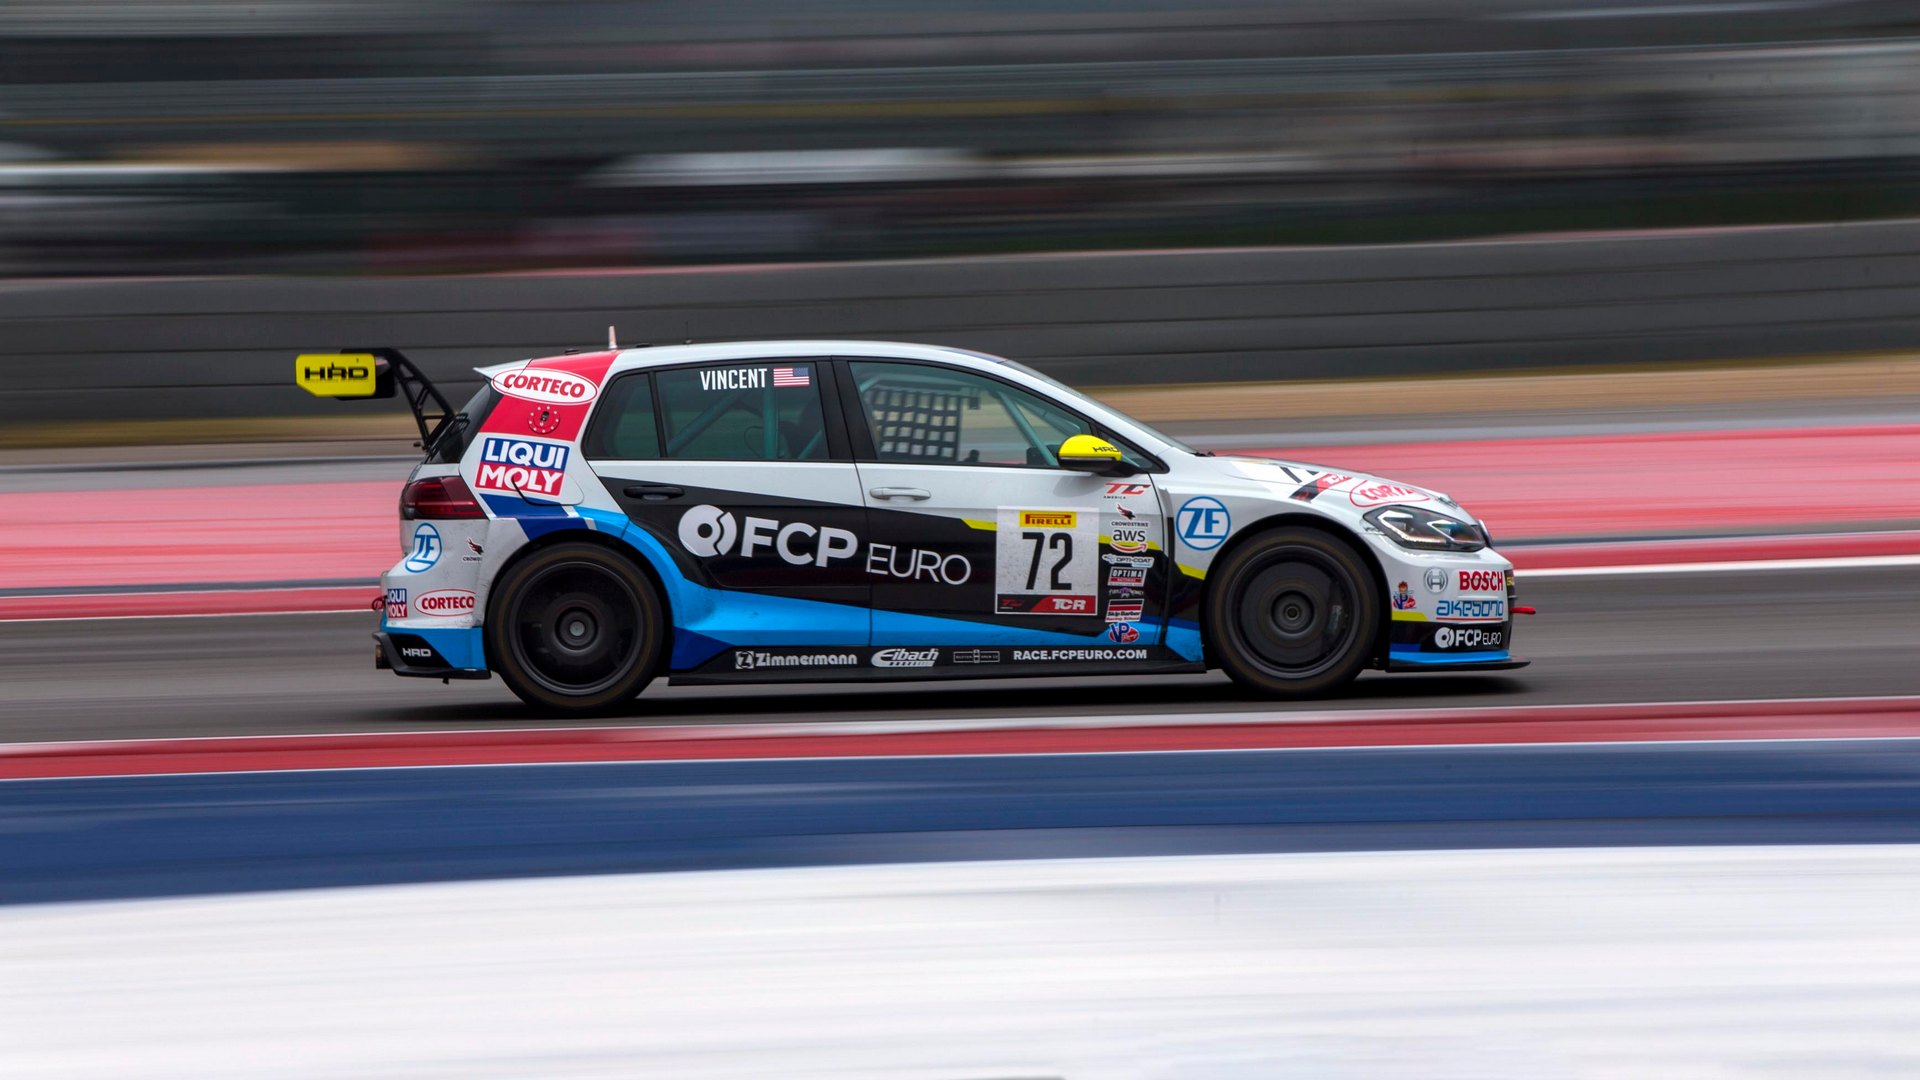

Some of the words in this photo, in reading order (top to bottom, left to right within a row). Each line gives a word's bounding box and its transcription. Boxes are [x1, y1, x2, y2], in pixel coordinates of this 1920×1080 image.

[304, 367, 369, 380] HRD
[700, 368, 767, 391] VINCENT
[503, 373, 586, 399] CORTECO
[485, 439, 566, 470] LIQUI
[479, 464, 563, 493] MOLY
[1105, 482, 1151, 495] TC
[1025, 514, 1072, 525] PIRELLI
[1112, 529, 1146, 542] aws
[740, 516, 858, 568] FCP
[866, 543, 971, 585] EURO
[1022, 532, 1073, 590] 72
[1112, 570, 1142, 578] OPTIMA
[1459, 571, 1503, 591] BOSCH
[421, 596, 474, 610] CORTECO
[1052, 598, 1087, 610] TCR
[1110, 622, 1130, 642] VP
[1455, 629, 1481, 646] FCP
[1482, 632, 1502, 645] EURO
[402, 648, 431, 657] HRD
[755, 653, 857, 666] Zimmermann
[871, 648, 940, 667] Eibach
[1013, 649, 1147, 660] RACE.FCPEURO.COM
